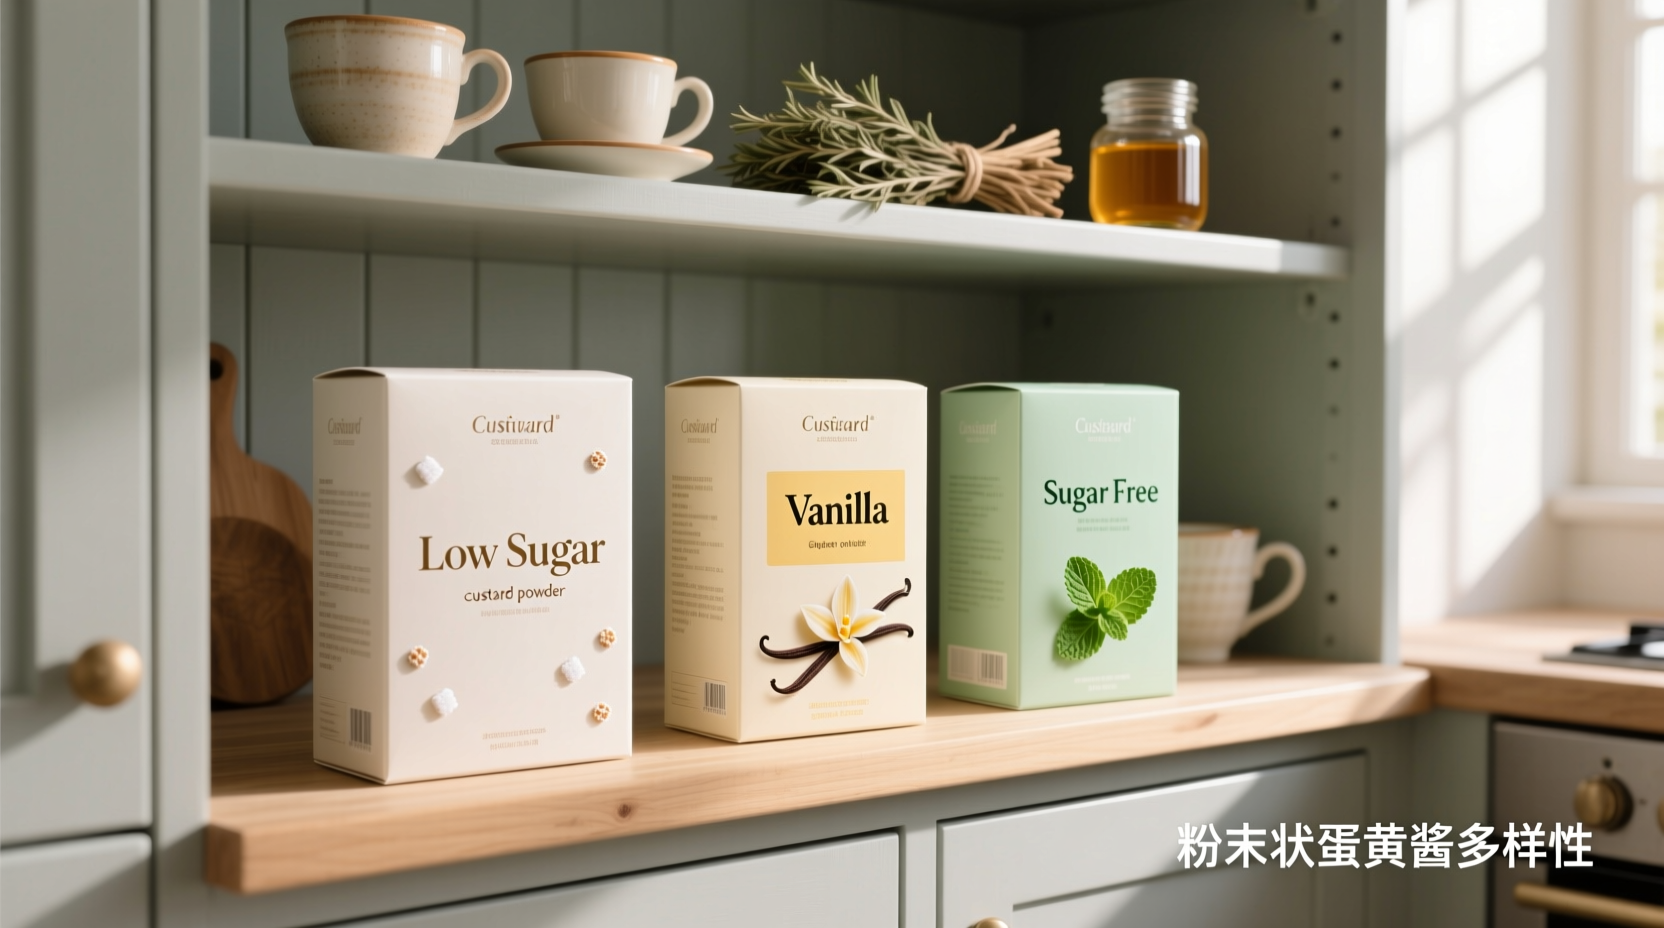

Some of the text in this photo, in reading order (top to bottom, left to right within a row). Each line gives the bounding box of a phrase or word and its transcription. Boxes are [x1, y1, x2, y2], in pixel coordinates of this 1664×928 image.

[785, 490, 889, 527] Vanilla
[1044, 478, 1159, 514] Sugar Free
[418, 532, 606, 577] Low Sugar
[464, 583, 566, 604] custard powder
